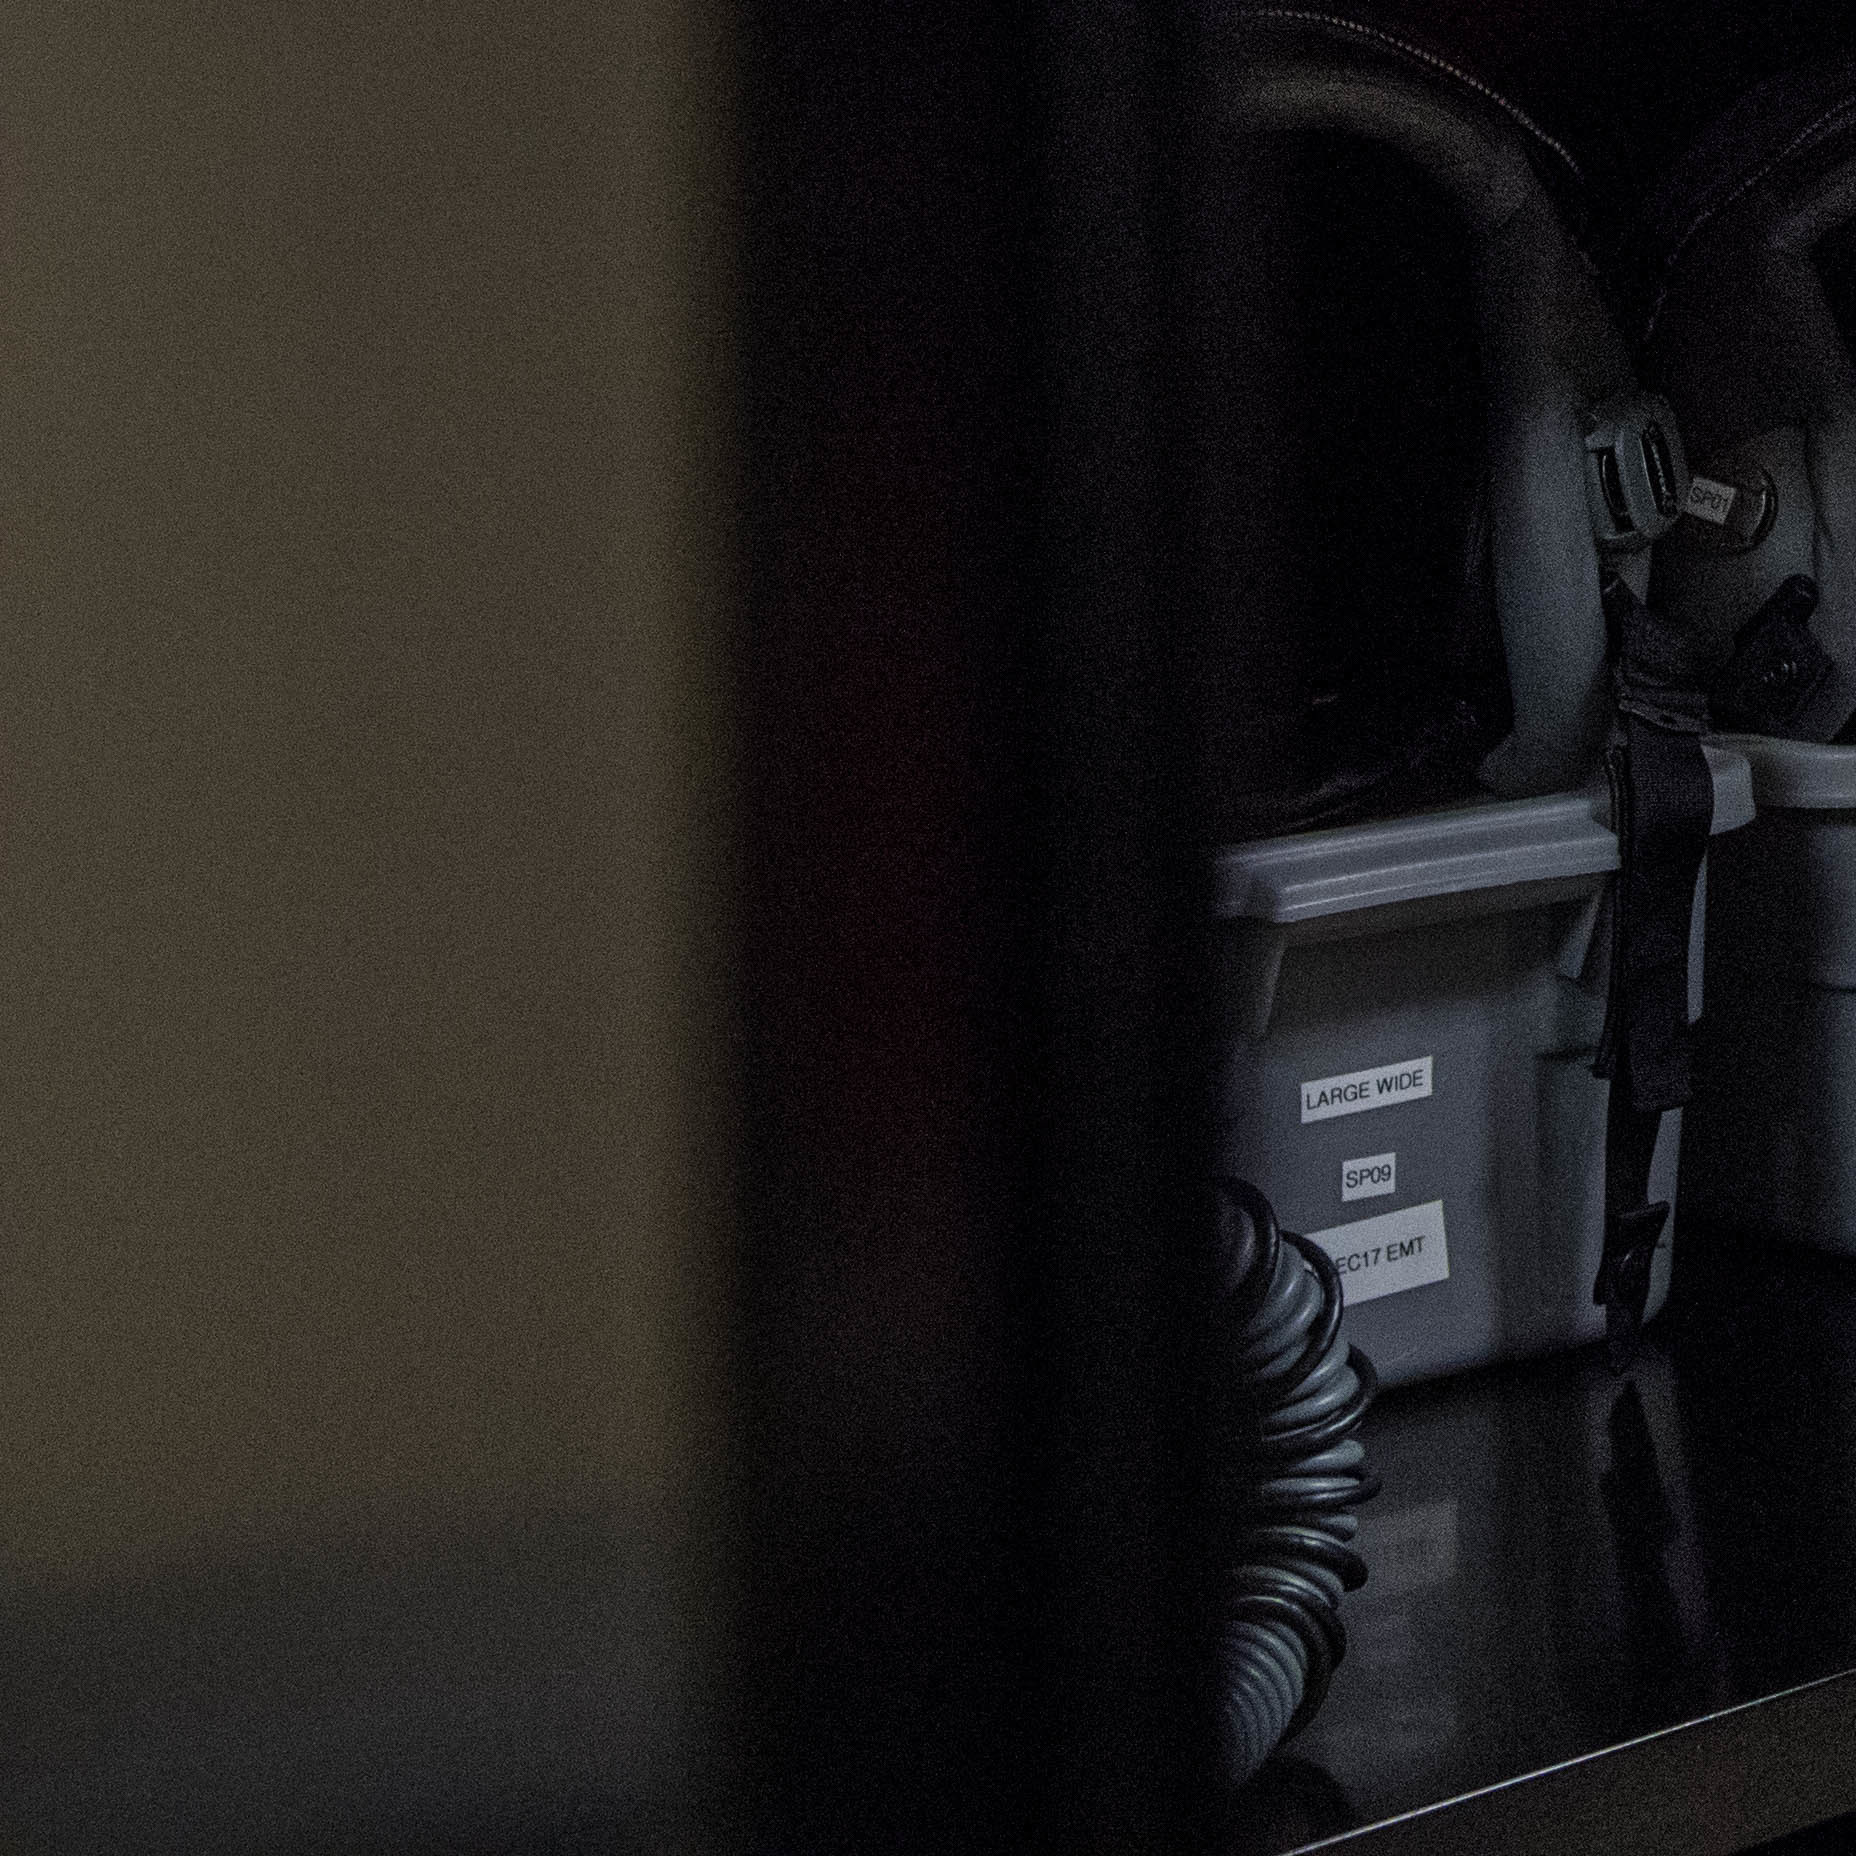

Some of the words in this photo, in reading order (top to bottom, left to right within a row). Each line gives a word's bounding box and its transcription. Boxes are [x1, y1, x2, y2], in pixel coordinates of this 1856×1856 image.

[1305, 1080, 1371, 1111] LARGE
[1376, 1068, 1424, 1097] WIDE
[1345, 1163, 1392, 1190] SP09
[1334, 1247, 1382, 1276] EC17
[1386, 1235, 1427, 1263] EMT
